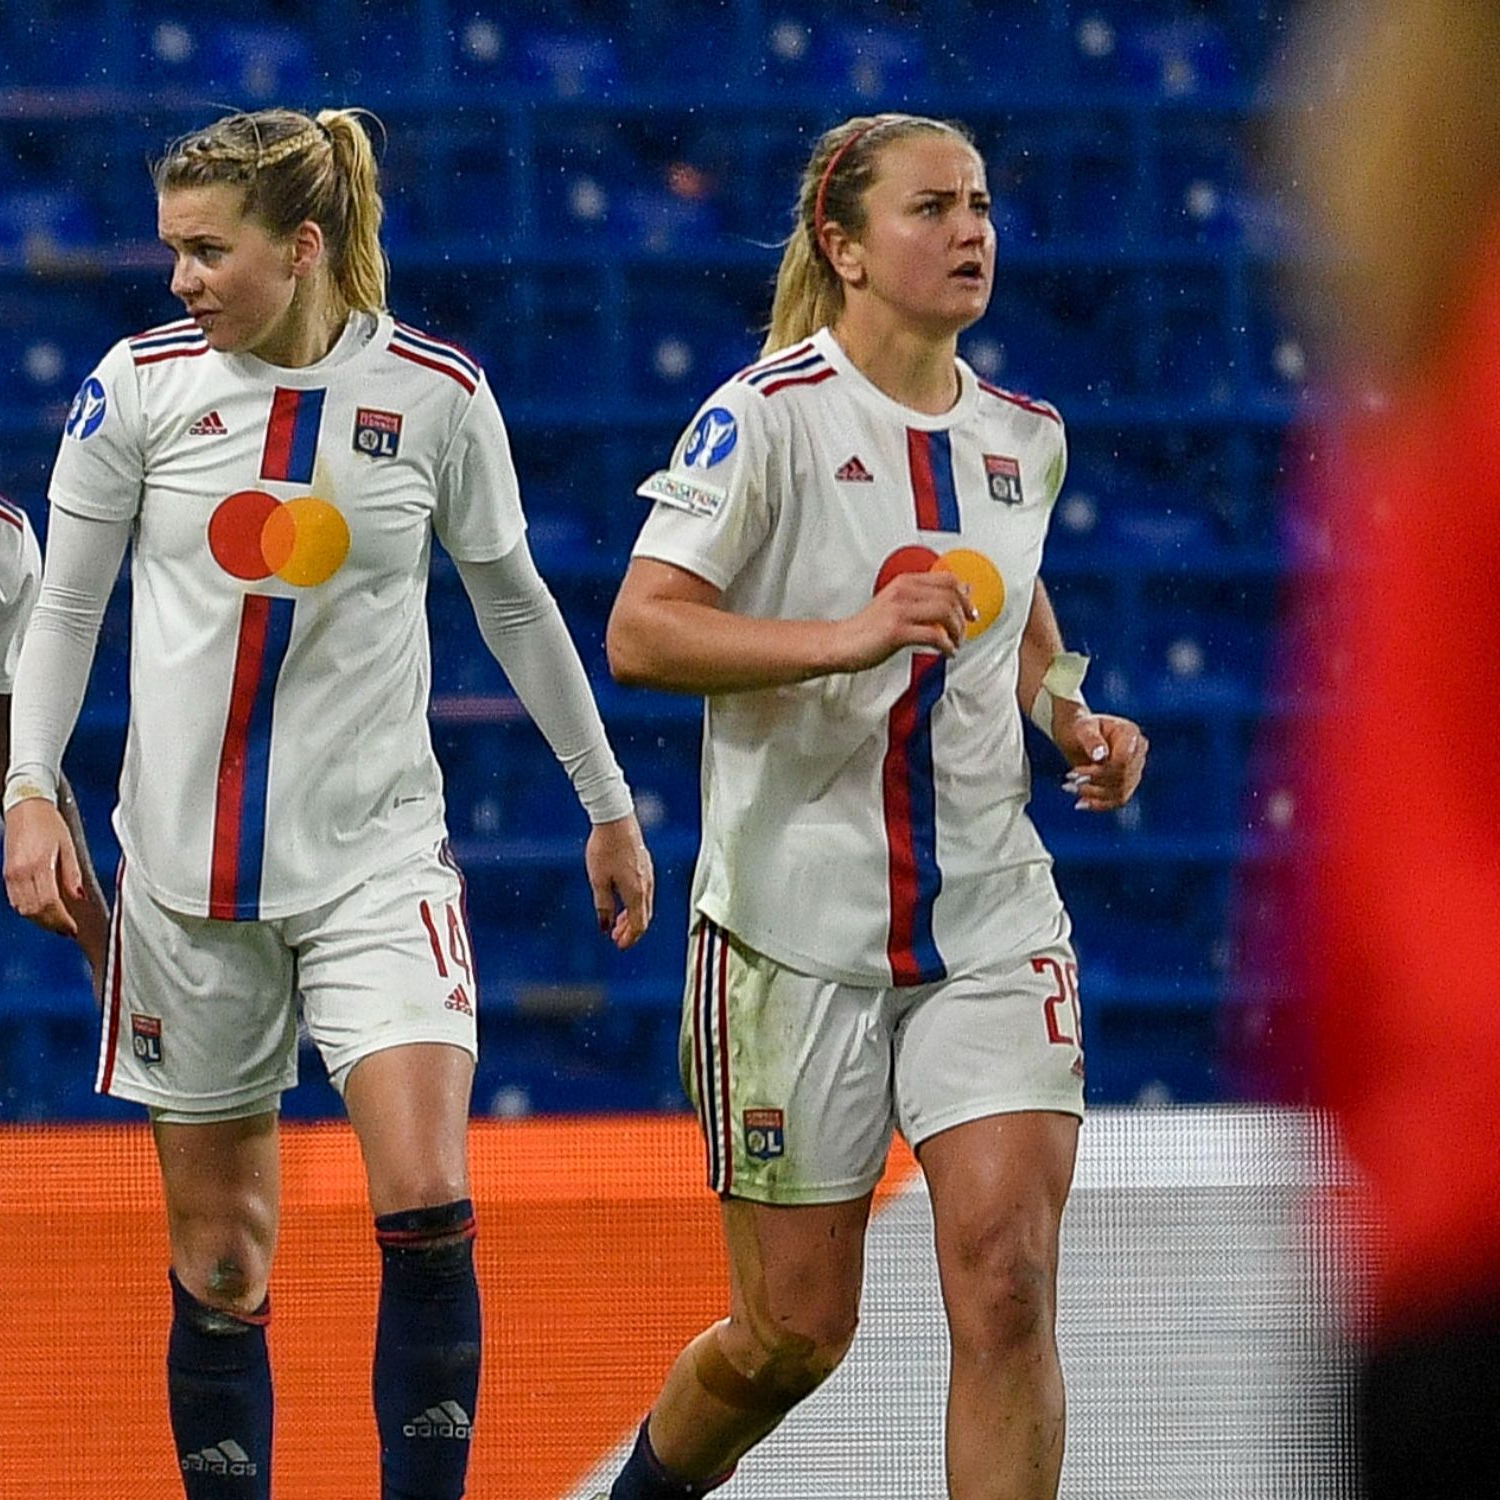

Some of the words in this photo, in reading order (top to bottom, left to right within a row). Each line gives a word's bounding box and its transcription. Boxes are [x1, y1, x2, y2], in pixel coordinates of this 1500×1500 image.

[358, 429, 394, 455] OL
[992, 477, 1021, 501] OL
[419, 898, 472, 985] 14
[134, 1035, 160, 1060] OL
[748, 1130, 781, 1153] OL
